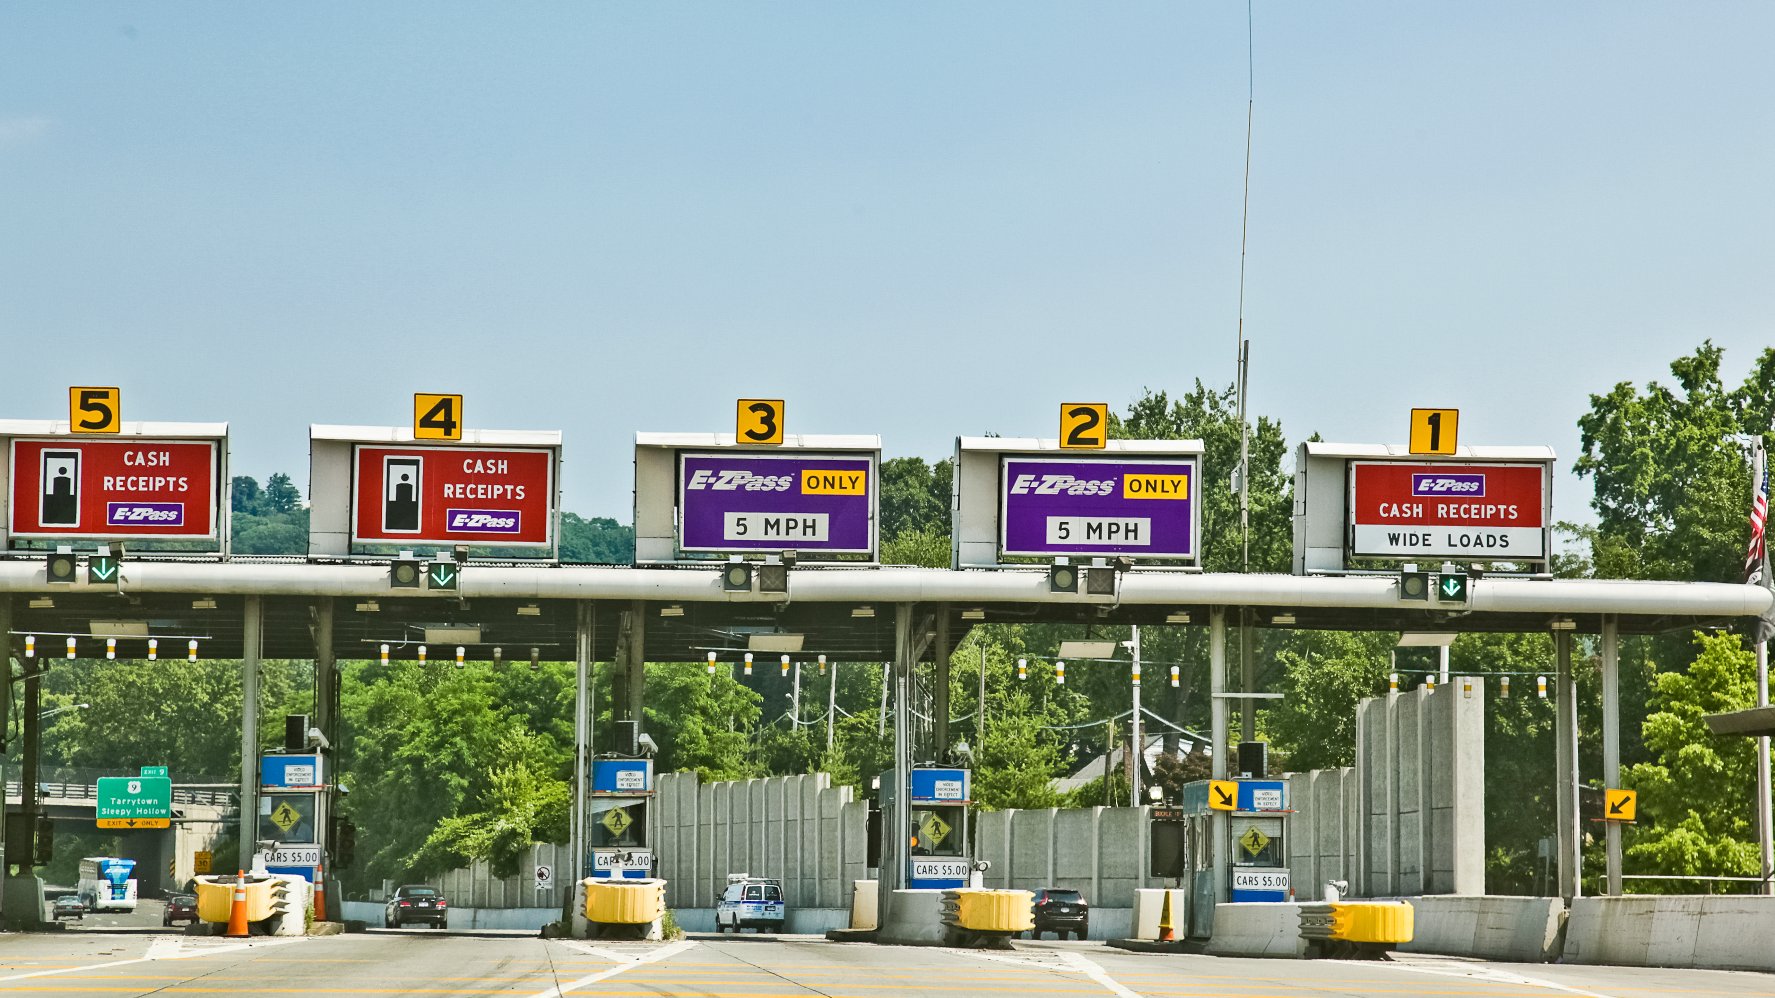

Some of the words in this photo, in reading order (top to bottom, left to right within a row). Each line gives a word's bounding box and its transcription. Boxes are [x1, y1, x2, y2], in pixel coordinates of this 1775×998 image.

[79, 390, 112, 430] 5
[420, 398, 456, 436] 4
[744, 403, 776, 441] 3
[1067, 407, 1099, 445] 2
[1428, 412, 1440, 450] 1
[124, 451, 169, 466] CASH
[463, 459, 508, 474] CASH
[104, 476, 188, 492] RECEIPTS
[687, 470, 793, 492] E-ZPass
[807, 476, 860, 489] ONLY
[1010, 474, 1116, 496] E-ZPass
[1129, 479, 1182, 493] ONLY
[1418, 479, 1480, 492] E-ZPass
[444, 484, 525, 500] RECEIPTS
[113, 507, 178, 521] E-ZPass
[1379, 503, 1423, 517] CASH
[1438, 504, 1518, 519] RECEIPTS
[452, 514, 515, 528] E-ZPass
[736, 518, 748, 535] 5
[764, 518, 816, 536] MPH
[1058, 522, 1070, 539] 5
[1086, 522, 1138, 540] MPH
[1388, 532, 1432, 546] WIDE
[1448, 533, 1509, 548] LOADS
[110, 798, 158, 806] Tarrytown
[102, 808, 131, 816] Sleepy
[265, 852, 287, 862] CARS
[292, 852, 317, 862] $5.00
[917, 865, 938, 875] CARS
[943, 865, 967, 875] $5.00
[1237, 876, 1258, 886] CARS
[1263, 876, 1287, 886] $5.00
